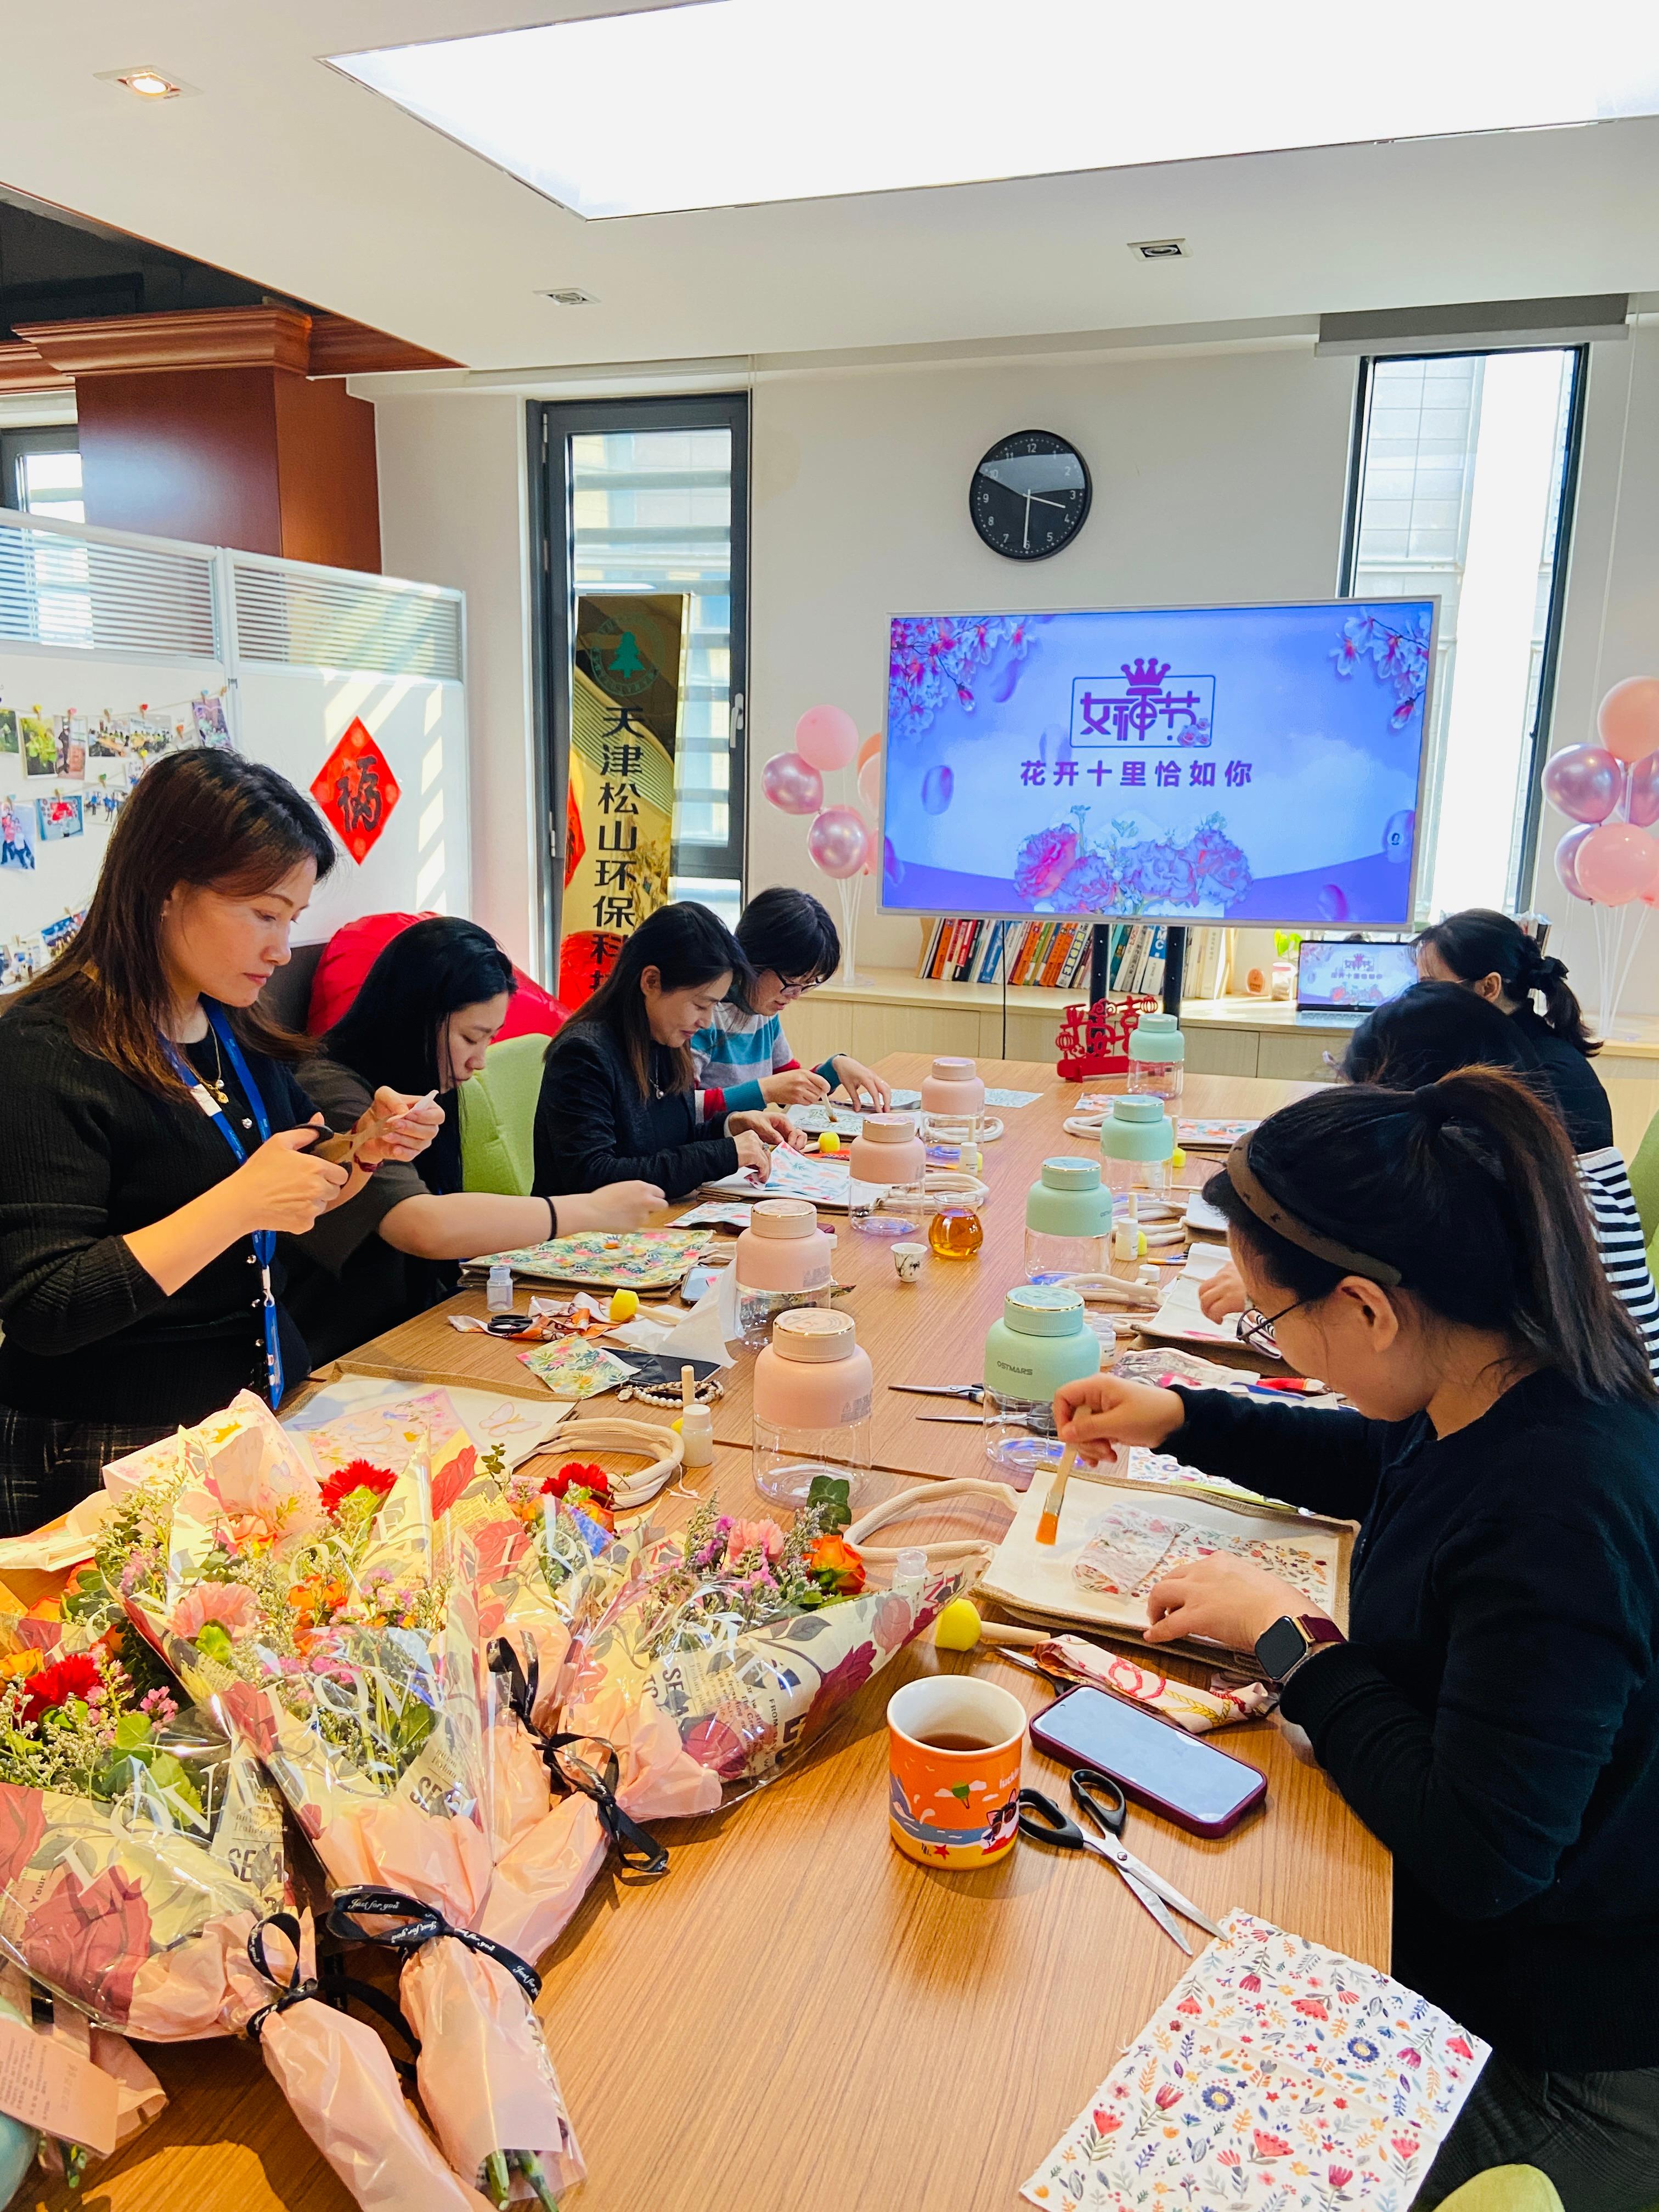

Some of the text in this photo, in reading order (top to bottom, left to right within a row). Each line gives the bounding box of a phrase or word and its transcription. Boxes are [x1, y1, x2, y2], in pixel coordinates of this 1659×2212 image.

[1027, 443, 1037, 453] 12
[1006, 452, 1014, 461] 11
[989, 469, 998, 479] 10
[1065, 466, 1071, 476] 2
[983, 493, 989, 503] 9
[1070, 490, 1076, 500] 3
[988, 516, 994, 526] 8
[1064, 514, 1070, 523] 4
[1003, 534, 1009, 543] 7
[1047, 532, 1053, 541] 5
[1080, 687, 1200, 741] 女神节
[1020, 759, 1252, 787] 花开十里恰如你
[996, 1361, 1033, 1375] OSTMARS
[768, 1699, 780, 1727] FROM
[348, 1899, 400, 1911] Just for you
[391, 1921, 437, 1943] Just for you
[477, 1941, 496, 1951] you
[512, 1965, 529, 1982] Just
